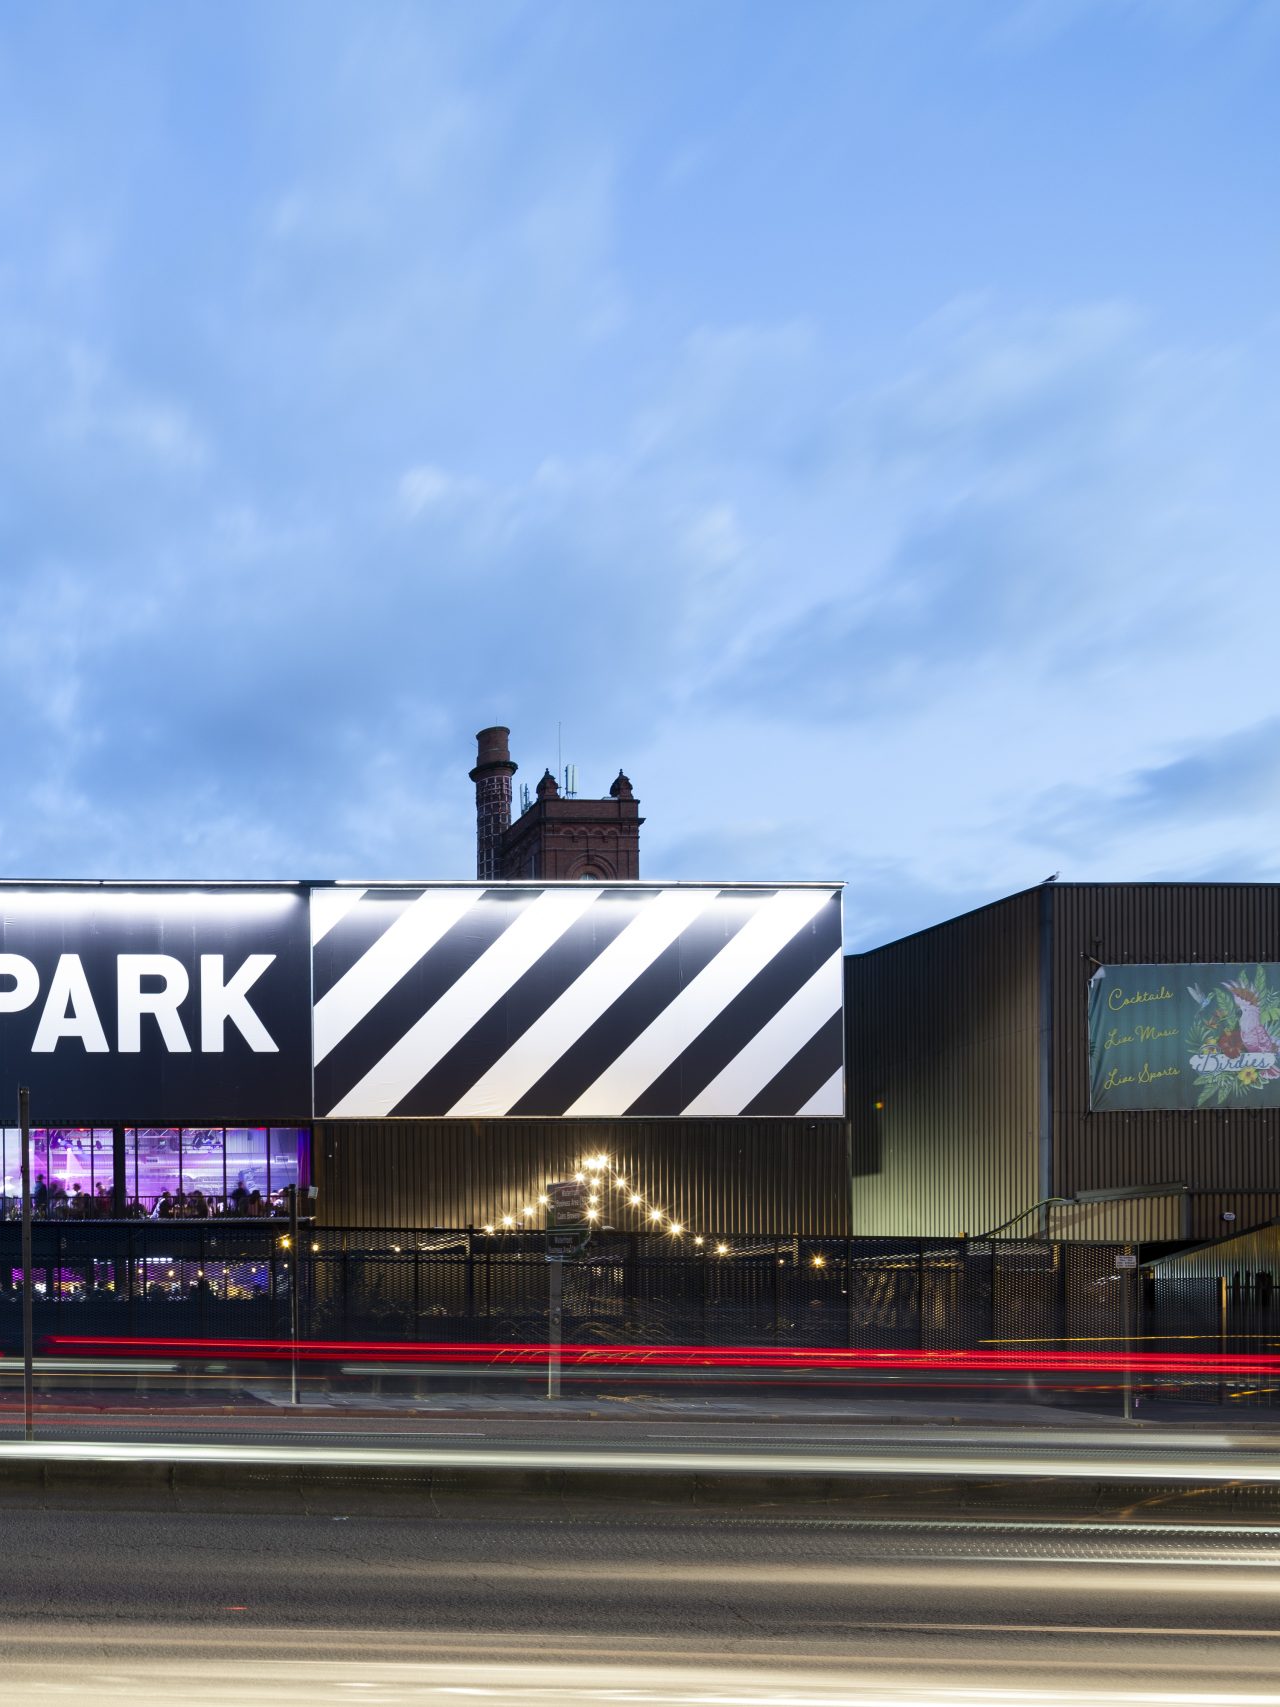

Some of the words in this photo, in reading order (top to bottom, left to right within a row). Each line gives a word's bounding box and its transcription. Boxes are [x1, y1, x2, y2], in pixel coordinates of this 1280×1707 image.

[1108, 986, 1174, 1010] Cocktails
[1104, 1028, 1135, 1049] Live
[1135, 1025, 1179, 1043] Music
[1196, 1046, 1271, 1073] Birdies
[1104, 1068, 1135, 1090] Live
[1138, 1063, 1180, 1084] Sports
